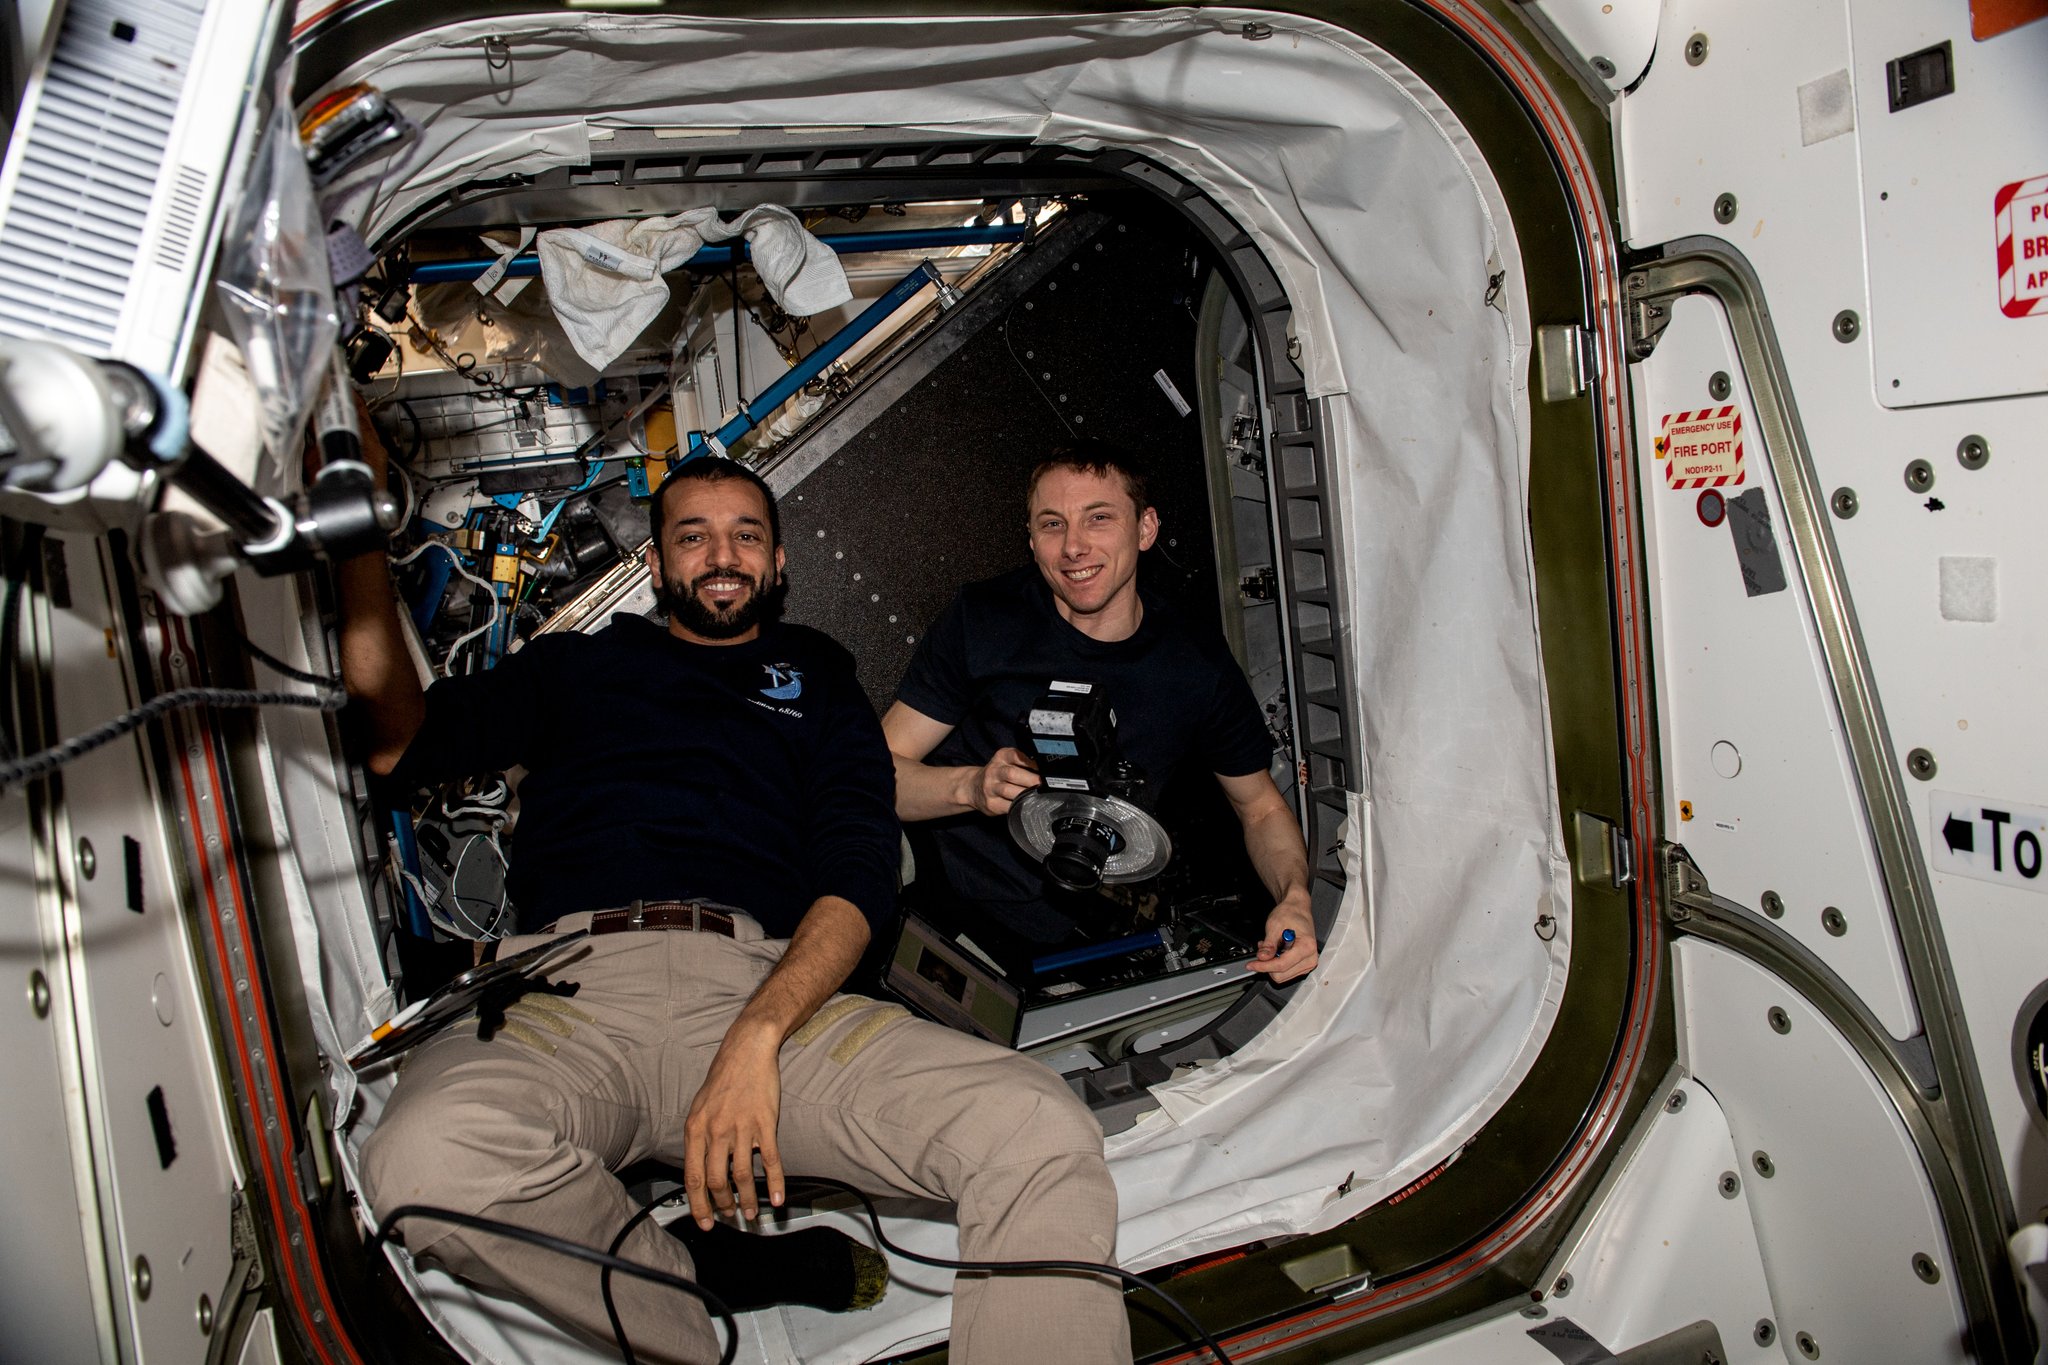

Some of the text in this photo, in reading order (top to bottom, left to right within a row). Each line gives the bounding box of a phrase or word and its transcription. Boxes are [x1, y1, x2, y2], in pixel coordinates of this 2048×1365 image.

[1671, 420, 1732, 435] EMERGENCY USE
[1673, 441, 1732, 458] FIRE PORT
[1981, 808, 2042, 879] To
